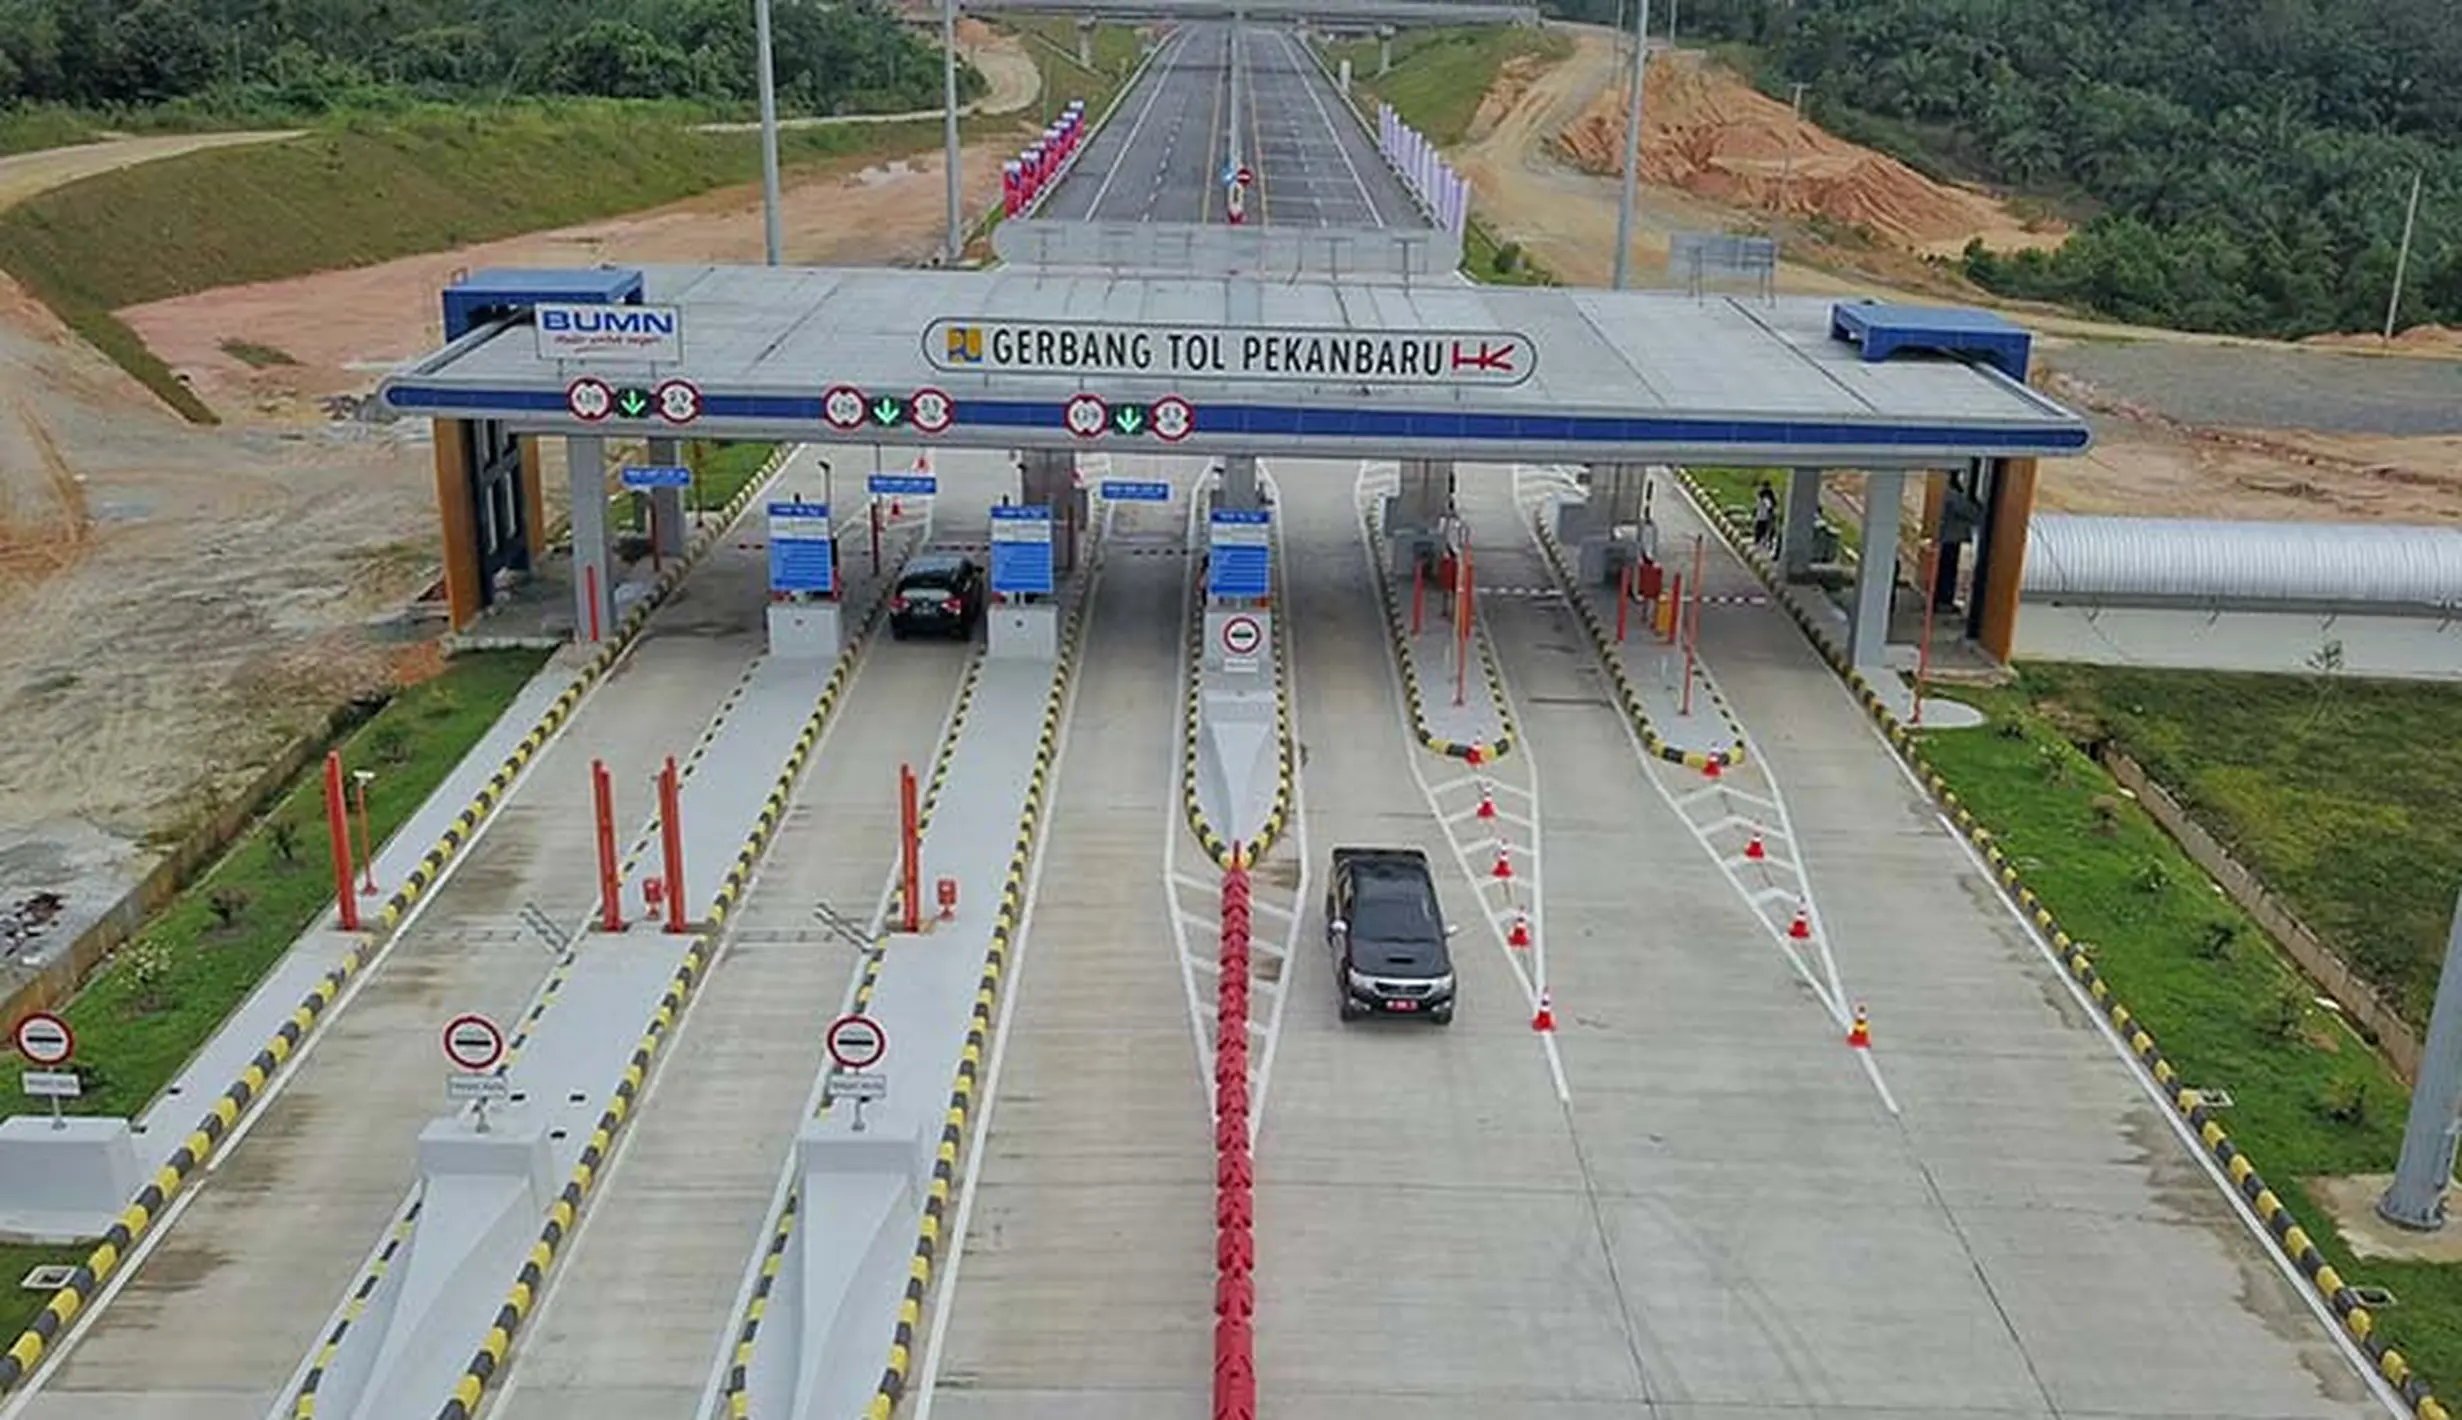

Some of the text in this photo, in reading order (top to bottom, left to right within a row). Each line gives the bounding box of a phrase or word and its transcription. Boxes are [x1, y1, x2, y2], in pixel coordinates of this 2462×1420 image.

[542, 311, 672, 333] BUMN
[992, 328, 1151, 368] GERBANG
[1168, 334, 1225, 370] TOL
[1243, 337, 1443, 376] PEKANBARU
[1452, 341, 1515, 371] HK
